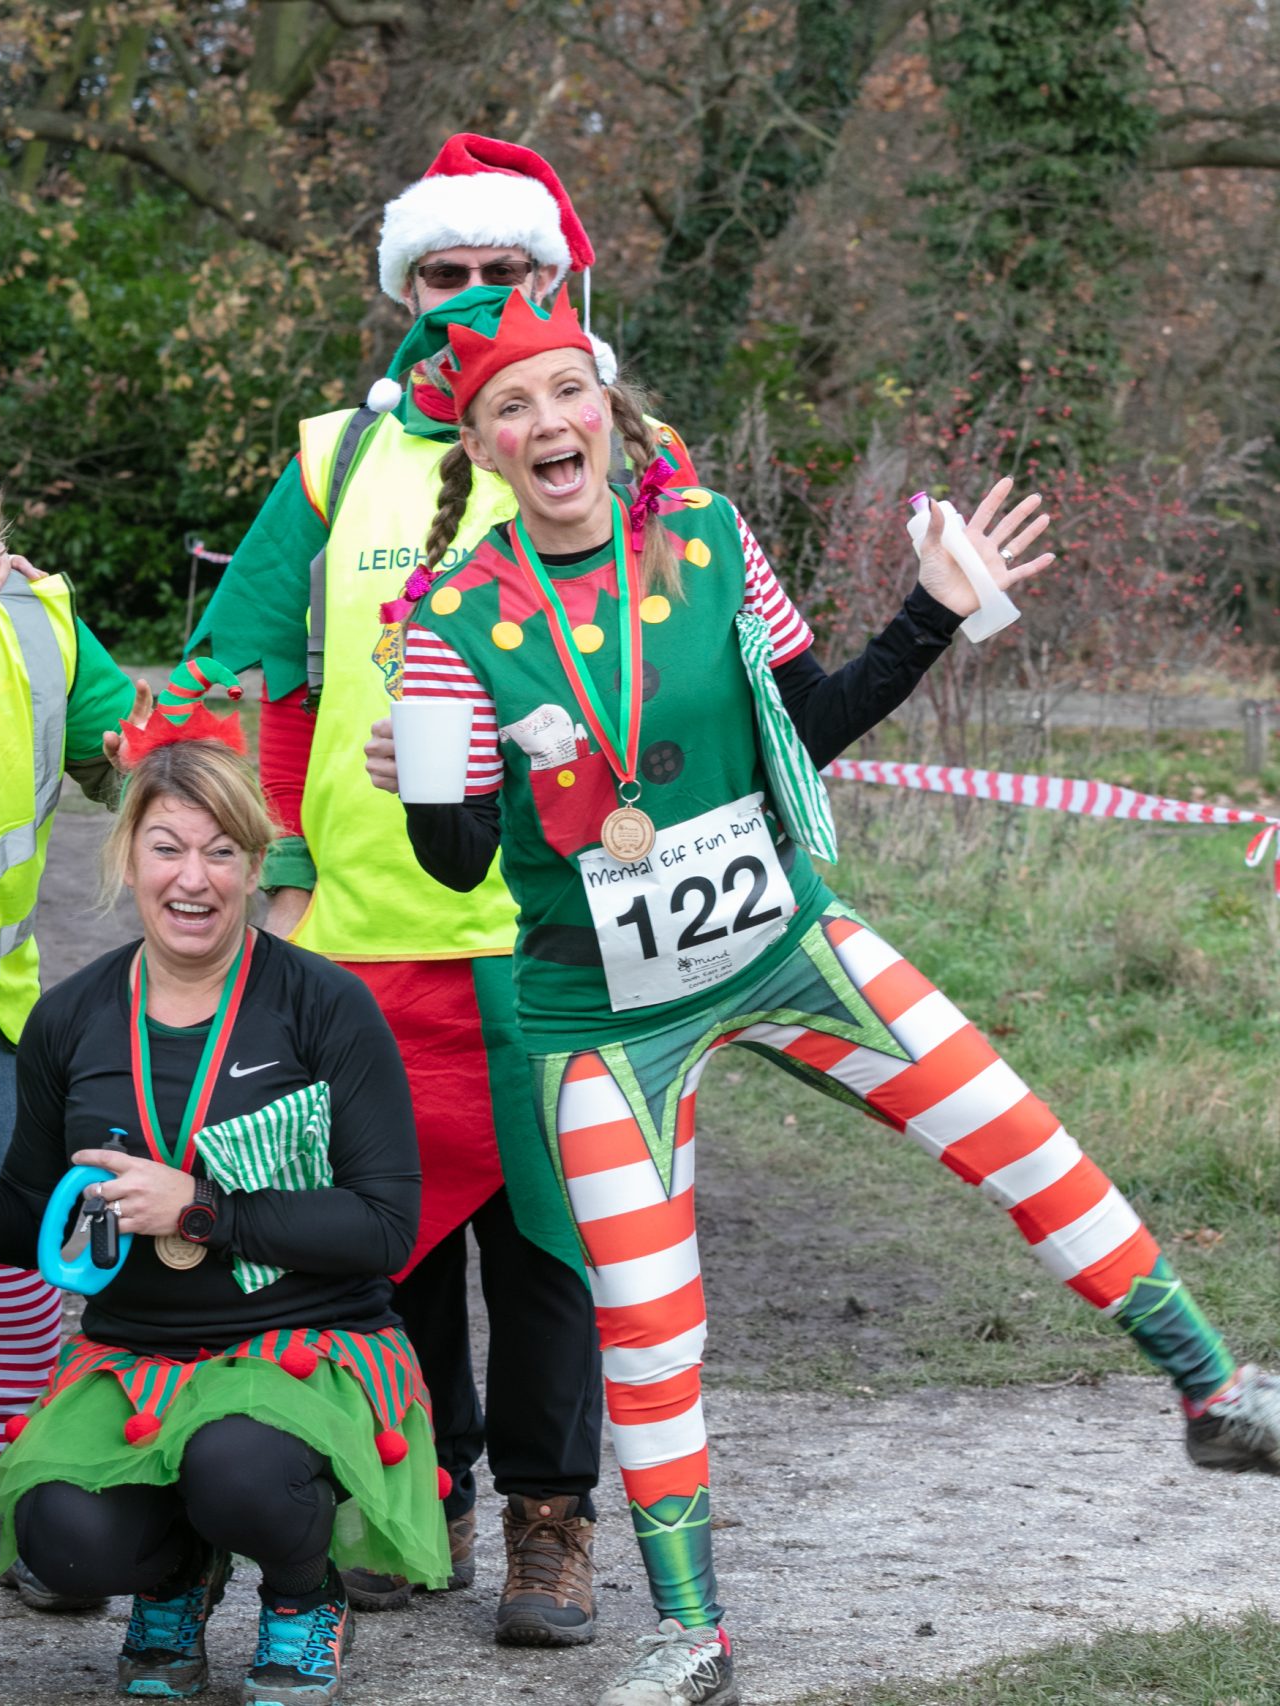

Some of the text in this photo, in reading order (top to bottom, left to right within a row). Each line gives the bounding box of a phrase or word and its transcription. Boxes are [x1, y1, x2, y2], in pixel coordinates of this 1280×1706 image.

[587, 816, 762, 888] Mental Elf Fun Run
[616, 855, 783, 960] 122
[695, 949, 730, 966] mind
